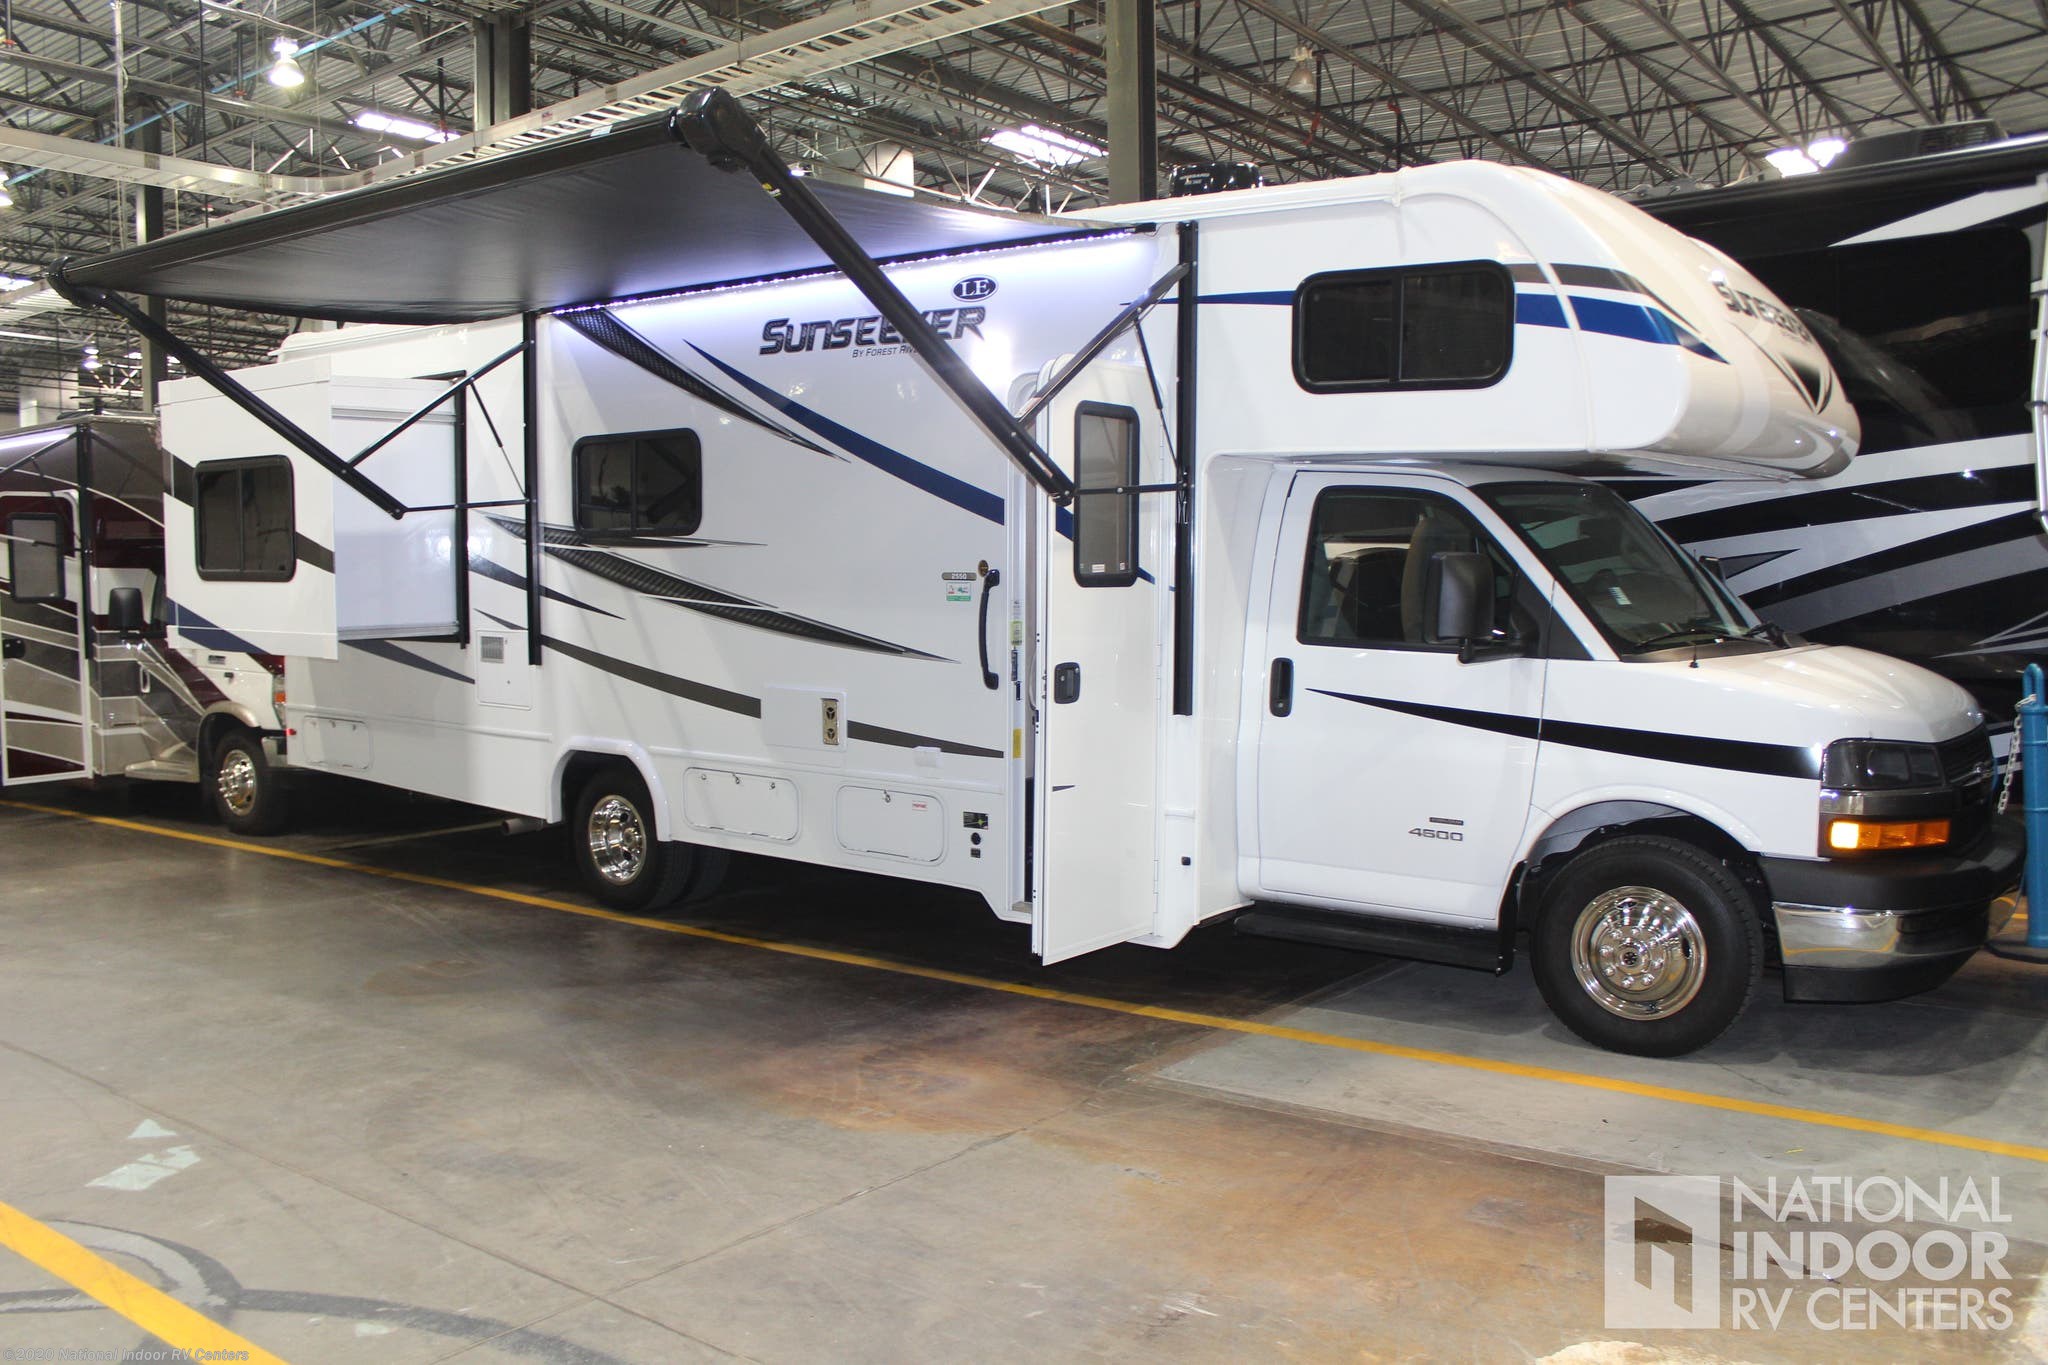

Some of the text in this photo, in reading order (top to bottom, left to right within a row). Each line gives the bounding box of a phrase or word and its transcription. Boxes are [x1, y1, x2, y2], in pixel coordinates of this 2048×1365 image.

[960, 280, 990, 297] LE
[759, 306, 985, 355] SUNSEEER
[1408, 828, 1463, 841] 4500
